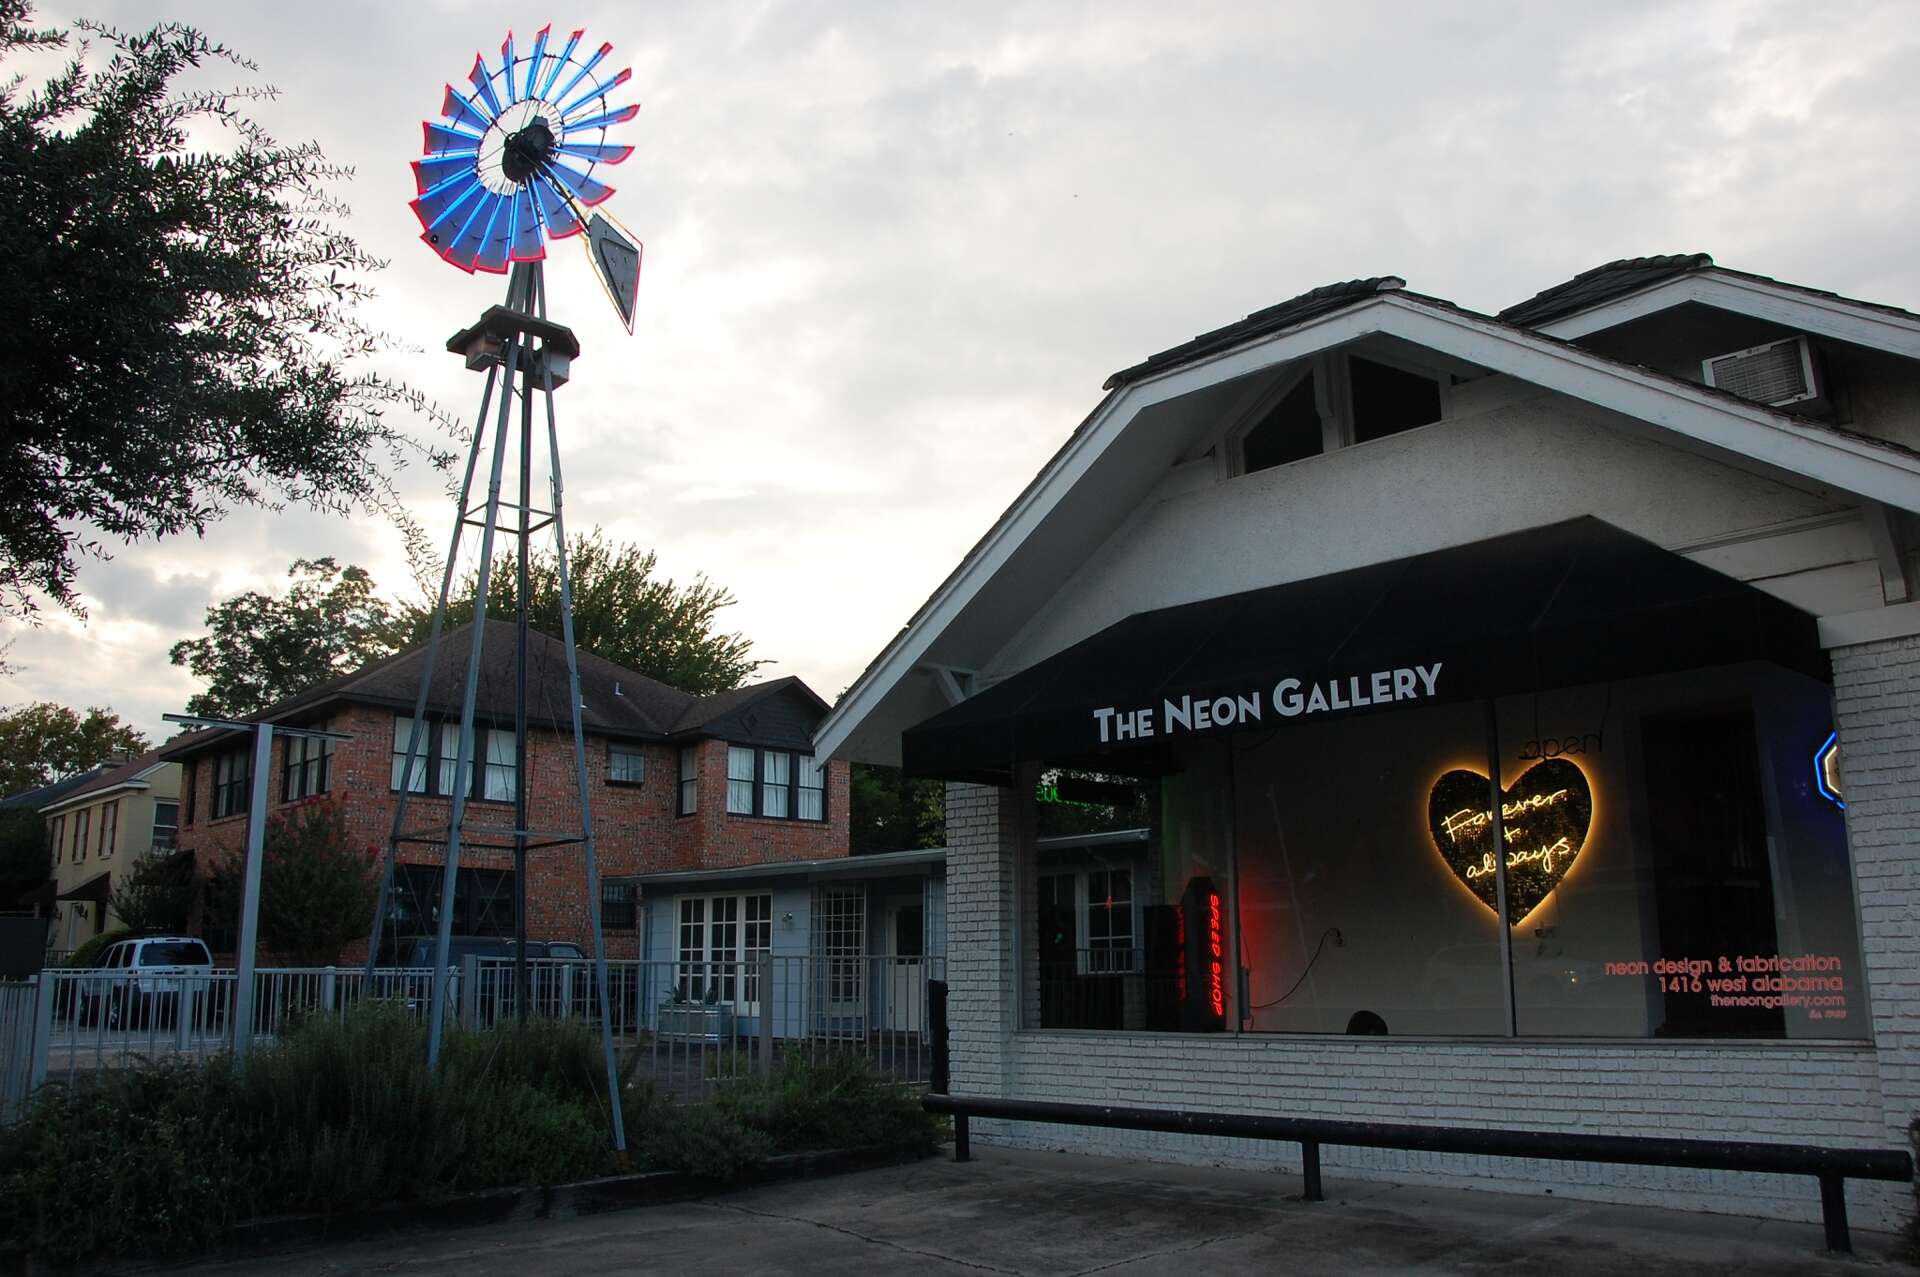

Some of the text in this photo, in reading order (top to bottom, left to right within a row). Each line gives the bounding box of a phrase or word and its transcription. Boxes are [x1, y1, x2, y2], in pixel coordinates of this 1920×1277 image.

[1093, 662, 1443, 743] THE NEON GALLERY
[1209, 893, 1224, 1017] SPEED SHOP
[1603, 953, 1841, 979] neon design & fabrication
[1658, 974, 1844, 993] 1416 west alabama
[1710, 993, 1846, 1010] theneongallery.com
